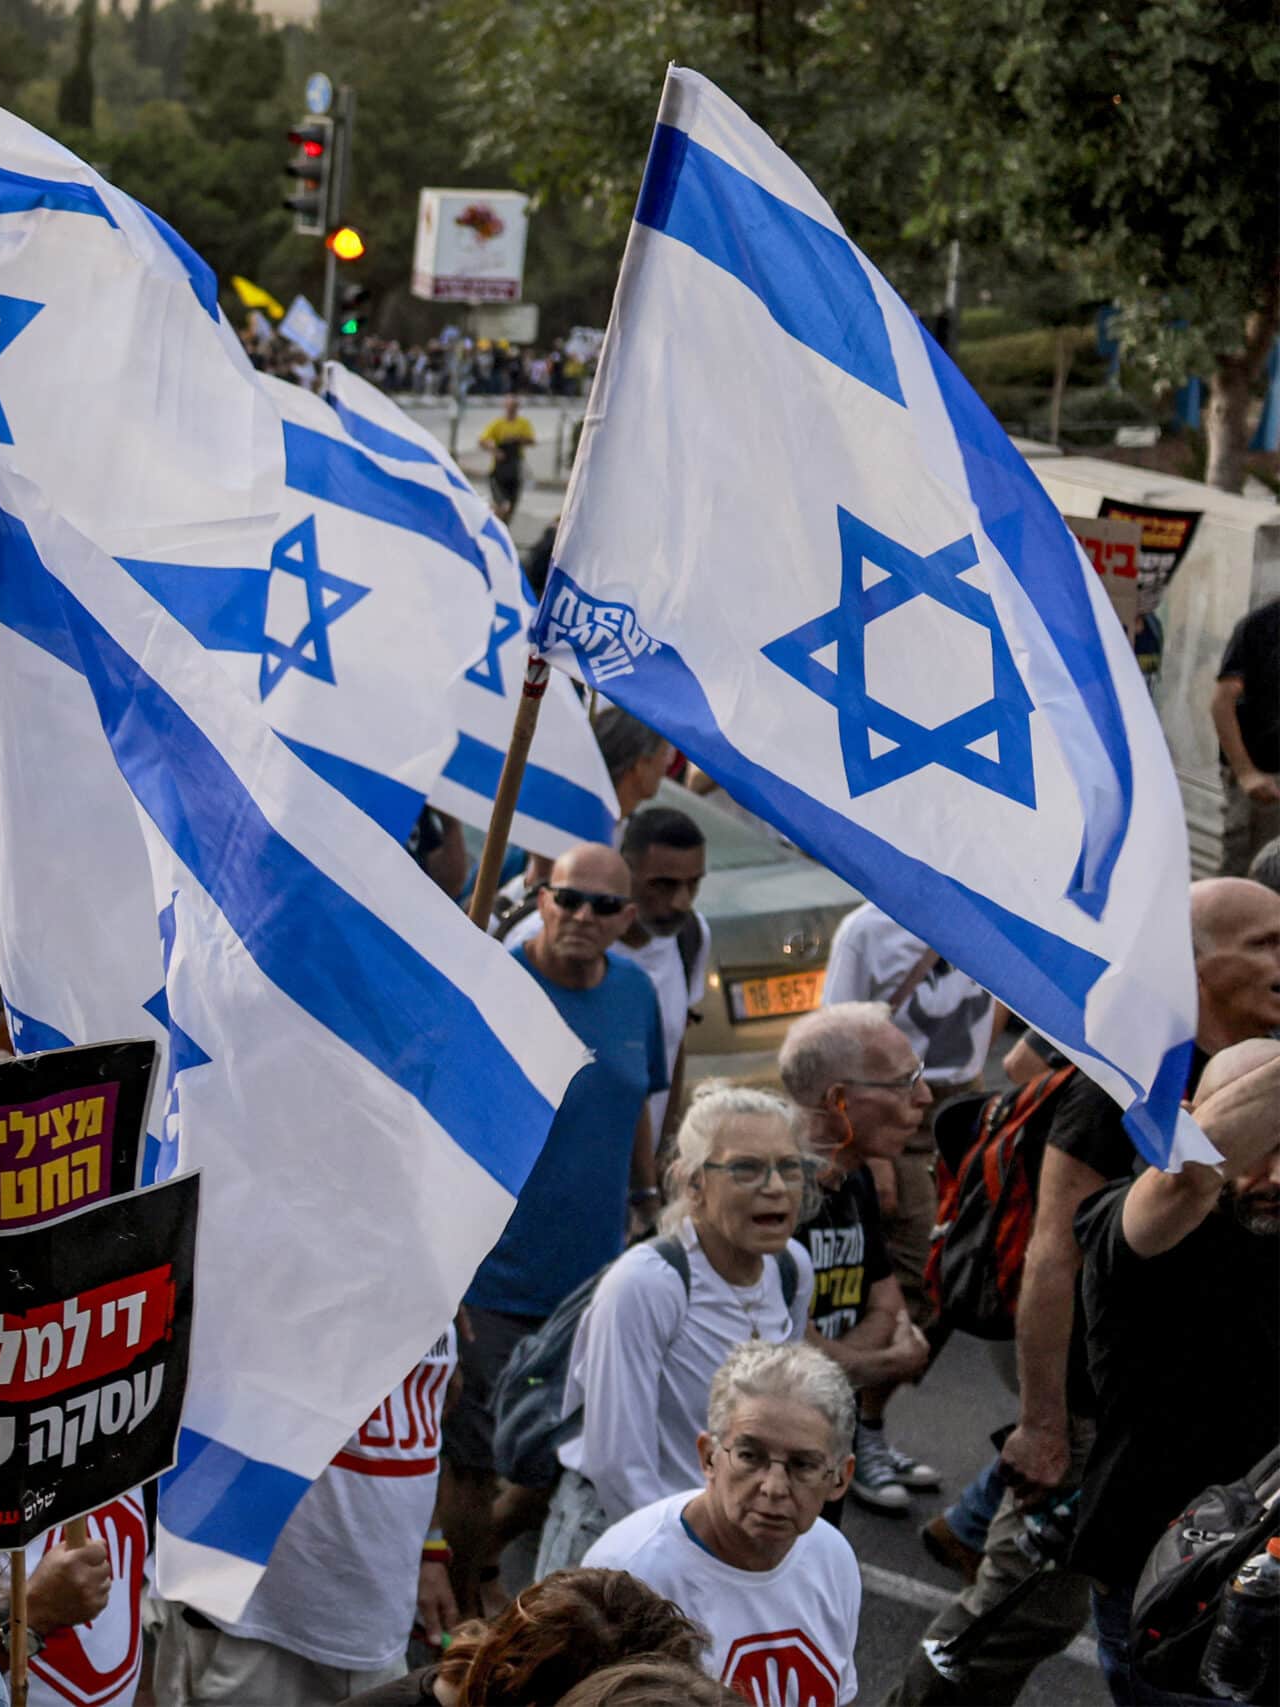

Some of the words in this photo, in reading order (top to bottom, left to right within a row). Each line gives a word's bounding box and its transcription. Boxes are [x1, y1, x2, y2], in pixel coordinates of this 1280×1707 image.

[100, 1290, 148, 1348] די
[28, 1362, 165, 1468] עסקה
[23, 1490, 57, 1522] שלום
